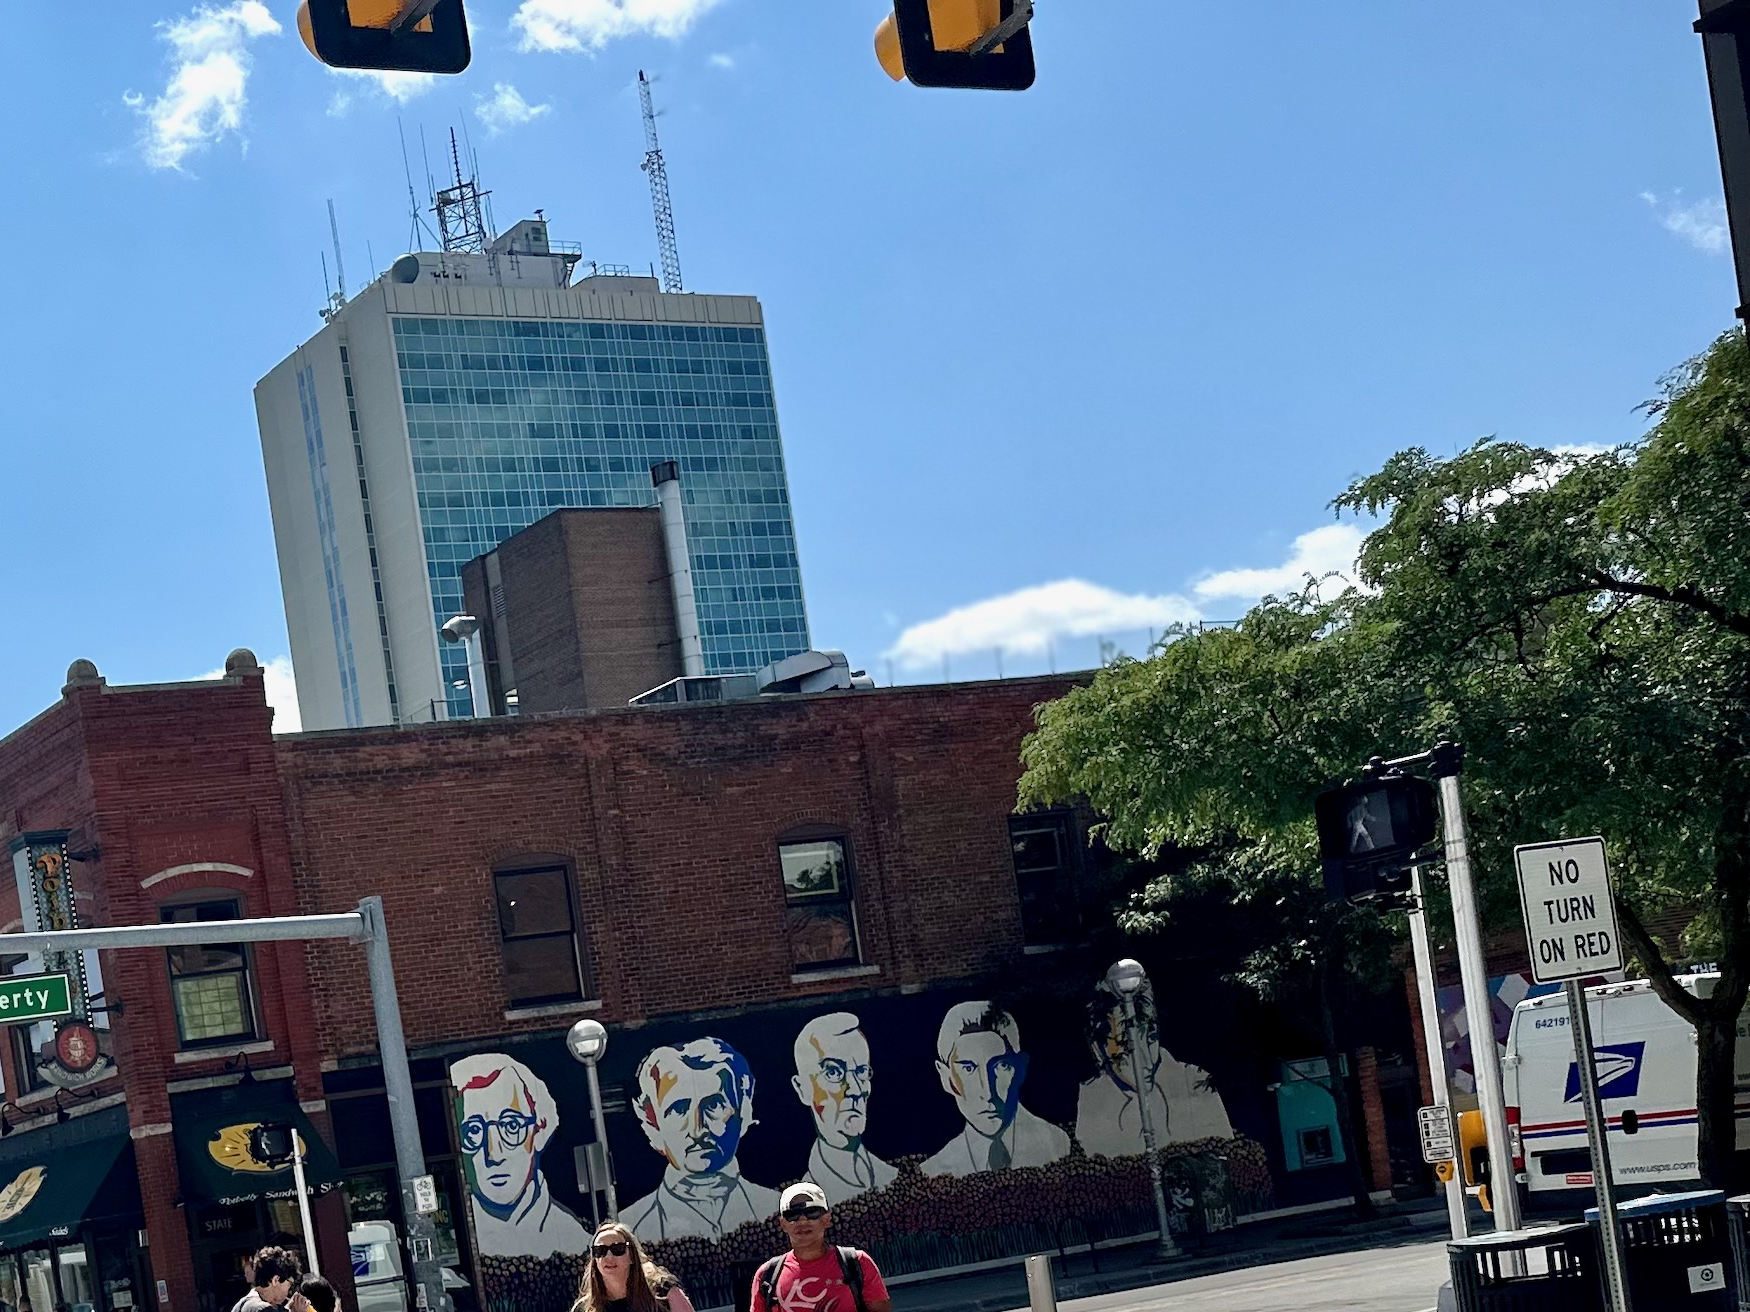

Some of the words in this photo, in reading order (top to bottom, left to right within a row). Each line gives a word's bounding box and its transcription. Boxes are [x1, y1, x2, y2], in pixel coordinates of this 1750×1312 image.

[1548, 858, 1580, 886] NO
[1543, 894, 1596, 925] TURN
[1539, 937, 1566, 964] ON
[1573, 931, 1611, 959] RED
[1618, 1161, 1696, 1175] www.usps.com
[264, 1184, 315, 1199] Sandwh
[205, 1217, 234, 1232] STATE
